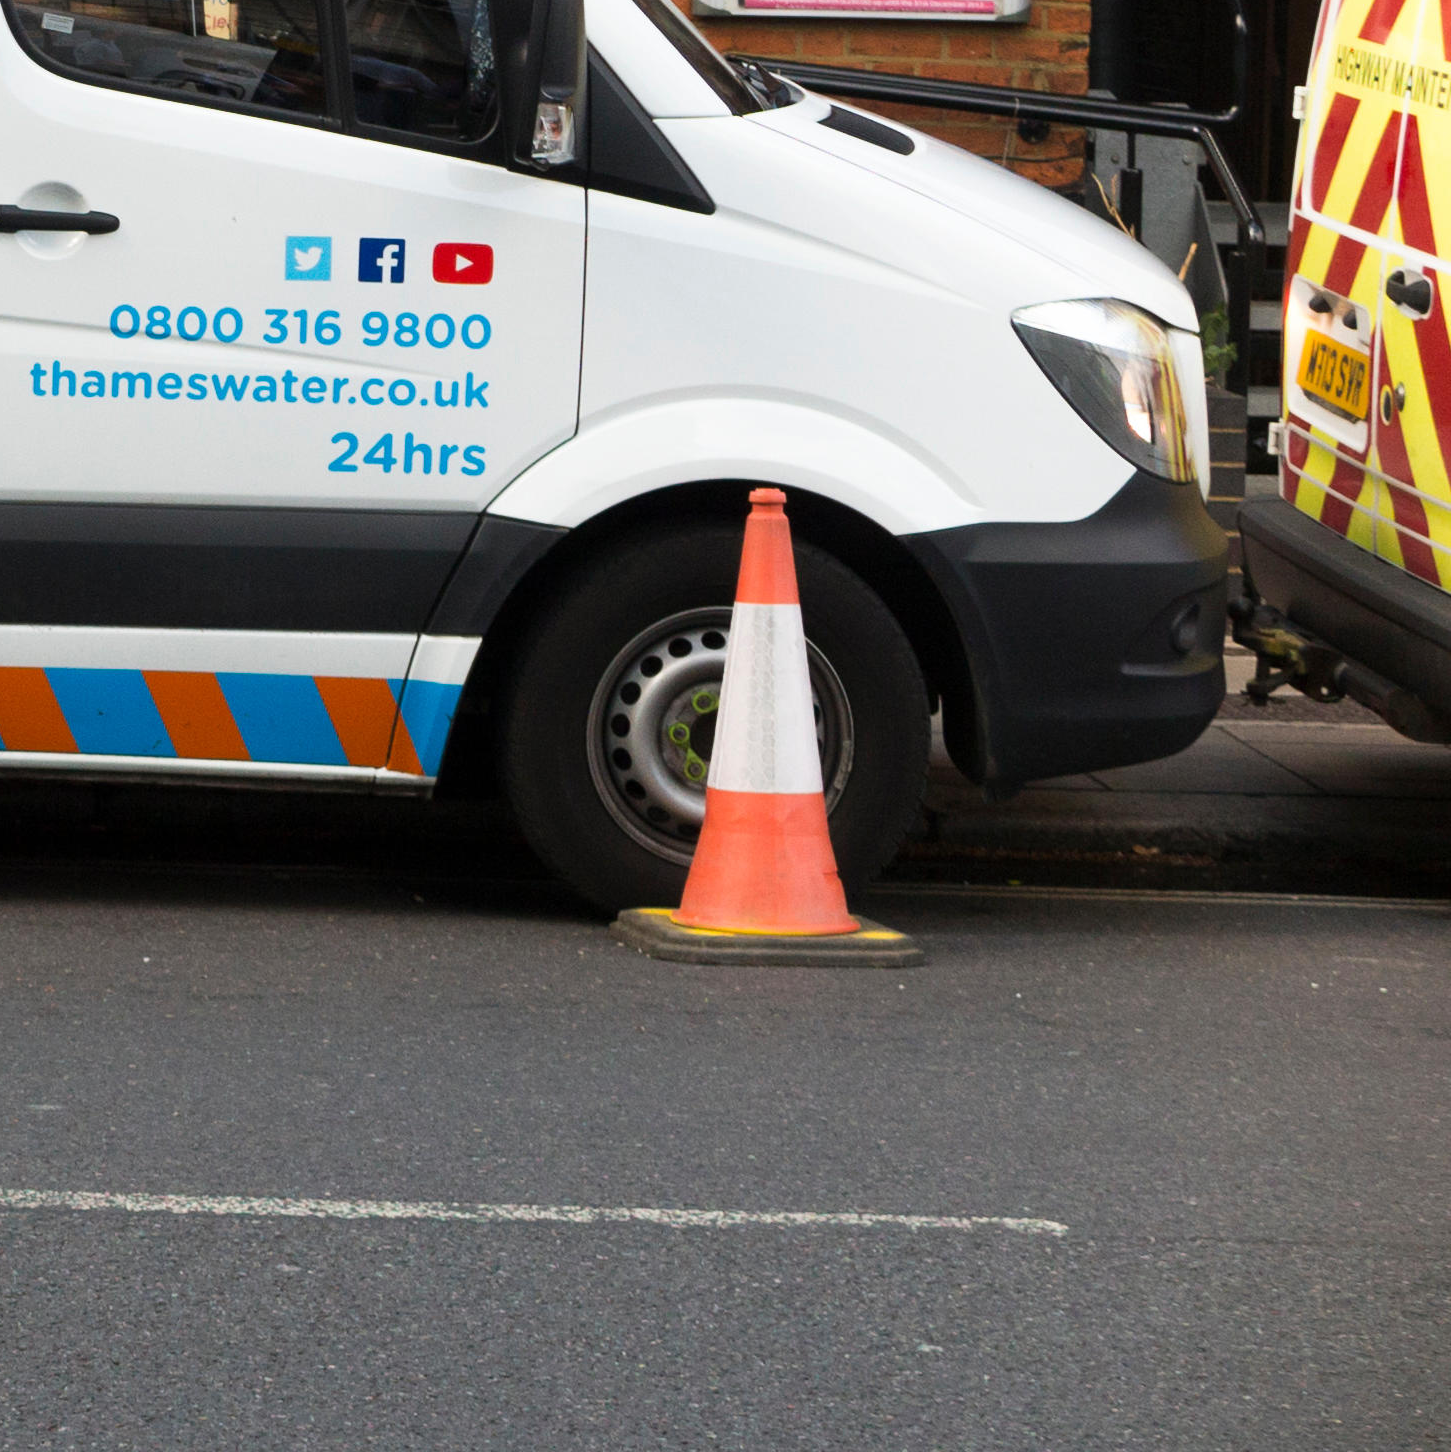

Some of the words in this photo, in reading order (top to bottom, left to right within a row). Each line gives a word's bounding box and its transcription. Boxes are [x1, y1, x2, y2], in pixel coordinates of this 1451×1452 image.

[1333, 43, 1393, 93] HIGHWAY
[109, 304, 243, 344] 0800
[263, 308, 341, 346] 316
[362, 311, 492, 349] 9800
[30, 360, 489, 409] thameswater.co.uk
[328, 431, 487, 477] 24hrs
